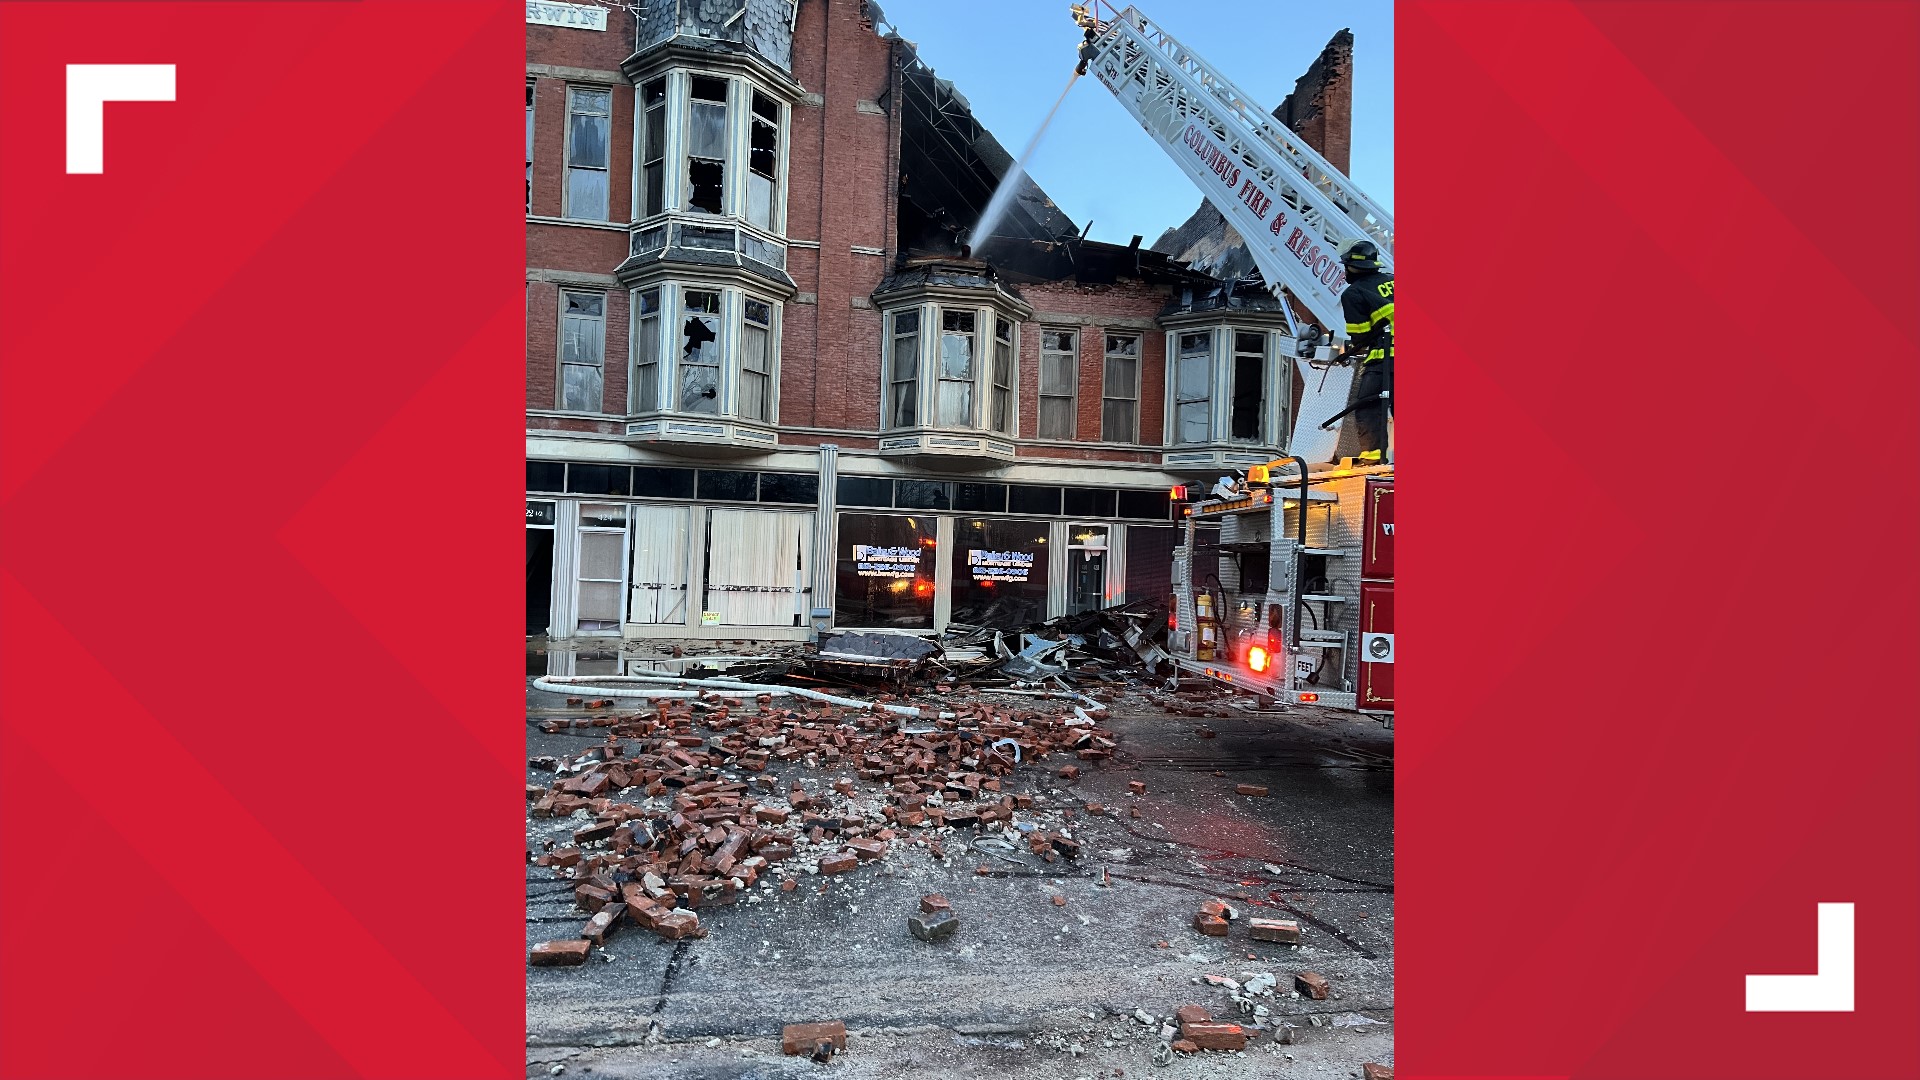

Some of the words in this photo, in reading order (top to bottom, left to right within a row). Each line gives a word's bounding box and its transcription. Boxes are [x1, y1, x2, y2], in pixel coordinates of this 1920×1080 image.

[1183, 124, 1242, 189] COLUMBUS
[1238, 178, 1273, 221] FIRE
[1269, 212, 1288, 236] &
[1284, 226, 1348, 297] RESCUE
[1297, 660, 1314, 674] FEET
